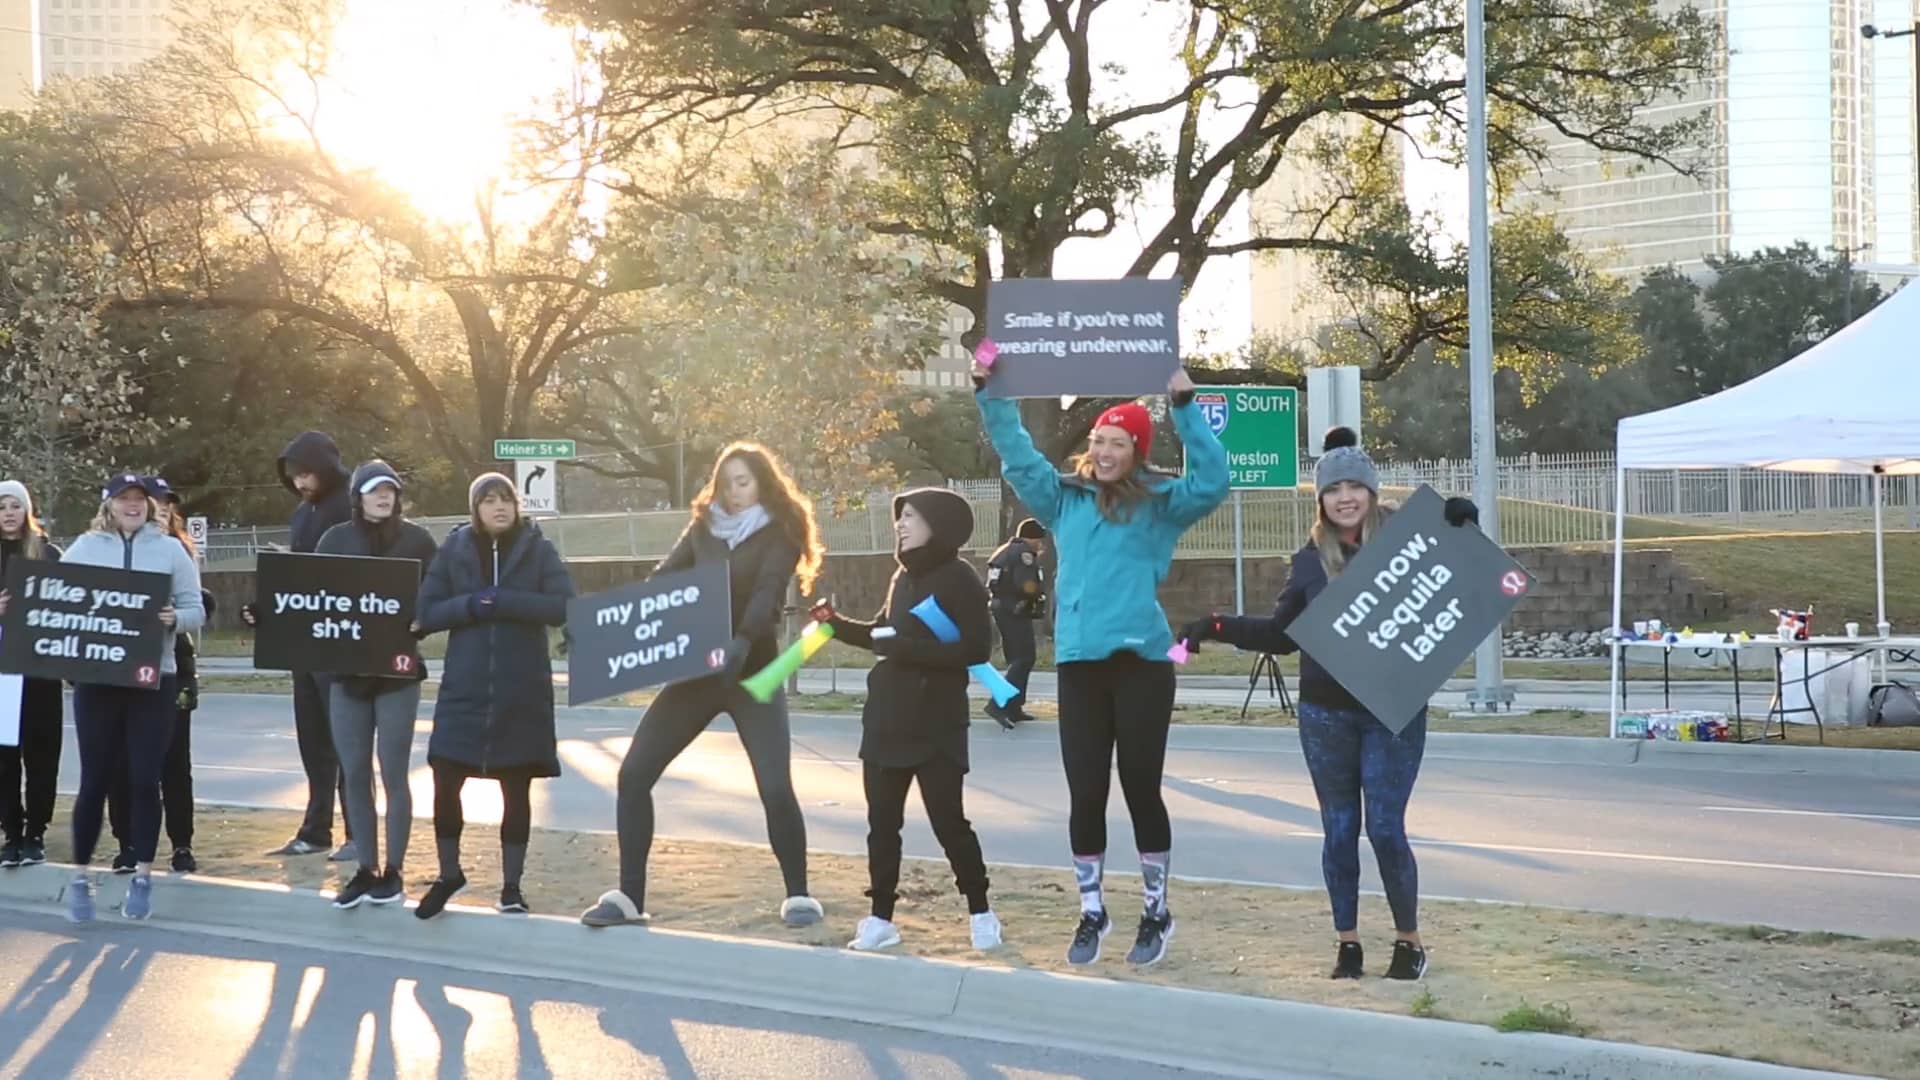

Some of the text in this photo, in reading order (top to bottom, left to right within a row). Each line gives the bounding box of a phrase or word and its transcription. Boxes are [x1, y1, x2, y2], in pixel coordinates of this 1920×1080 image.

[1004, 311, 1165, 331] Smile if you're not
[995, 337, 1173, 357] wearing underwear.
[1236, 392, 1290, 412] SOUTH
[500, 443, 552, 455] Heiner St
[1226, 450, 1279, 465] lveston
[1240, 470, 1268, 482] LEFT
[24, 576, 151, 611] i like your
[1332, 533, 1438, 638] run now,
[274, 589, 400, 614] you're the
[596, 586, 700, 626] my pace
[1366, 564, 1453, 649] tequila
[26, 608, 141, 636] stamina...
[634, 619, 663, 640] or
[1400, 598, 1464, 662] later
[34, 635, 126, 662] call me
[608, 634, 690, 679] yours?
